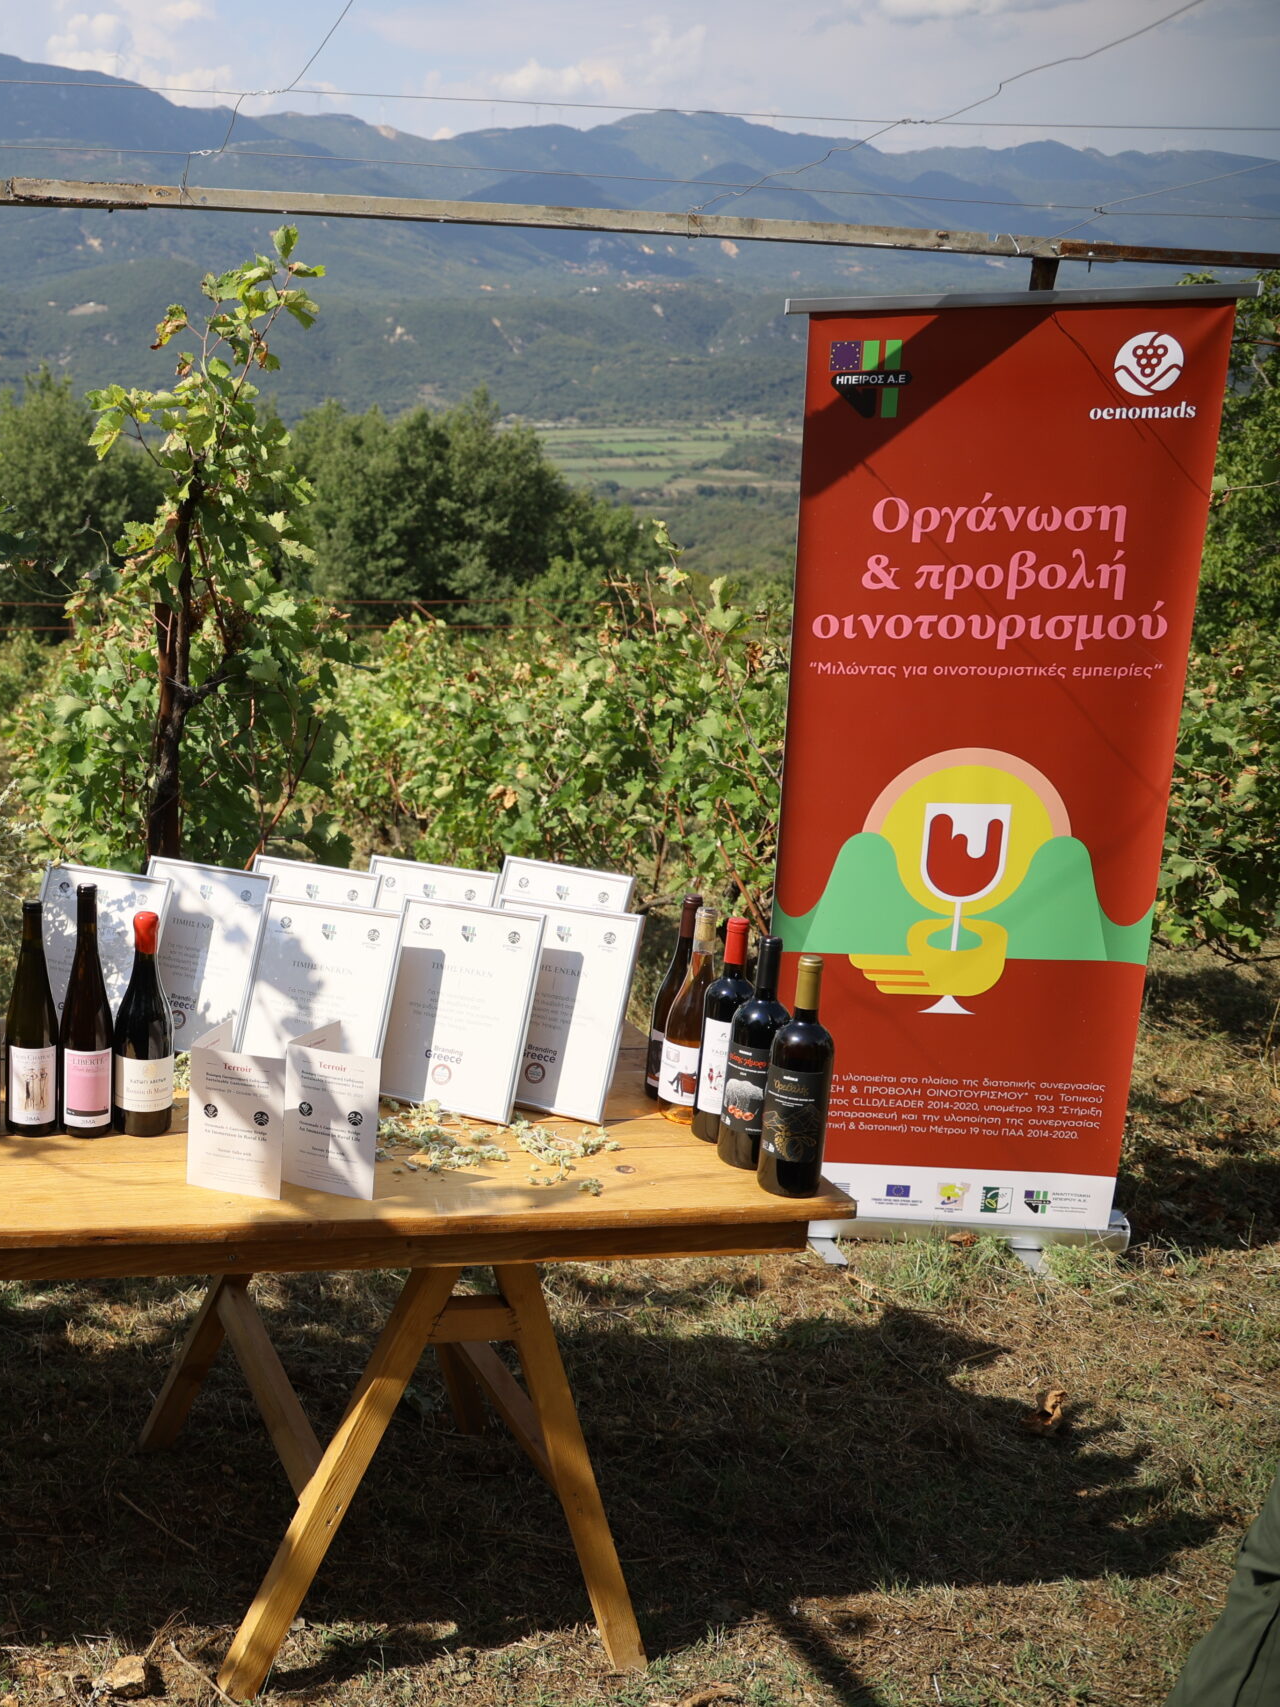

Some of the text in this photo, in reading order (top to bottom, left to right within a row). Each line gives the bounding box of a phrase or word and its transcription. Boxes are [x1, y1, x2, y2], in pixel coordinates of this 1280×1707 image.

[836, 374, 885, 386] ΗΠΕΙΡΟΣ
[1089, 401, 1197, 421] oenomads
[872, 492, 1128, 543] Οργάνωση
[861, 549, 1127, 600] & προβολή
[812, 600, 1169, 651] οινοτουρισμού
[902, 665, 929, 679] για
[933, 663, 1067, 680] οινοτουριστικές
[424, 1049, 462, 1064] Greece
[434, 1045, 464, 1057] Branding
[527, 1044, 558, 1056] Branding
[223, 1063, 252, 1073] Terroir
[319, 1062, 347, 1072] Terroir
[842, 1072, 897, 1083] υλοποιείται
[900, 1076, 918, 1084] στο
[922, 1075, 959, 1086] πλαίσιο
[962, 1078, 979, 1088] της
[982, 1077, 1036, 1090] διατοπικής
[1040, 1081, 1106, 1092] συνεργασίας
[850, 1085, 858, 1094] &
[863, 1086, 921, 1096] ΠΡΟΒΟΛΗ
[1034, 1093, 1054, 1102] του
[1059, 1093, 1103, 1104] Τοπικού
[853, 1097, 924, 1109] CLLD/LEADER
[927, 1101, 980, 1112] 2014-2020,
[984, 1104, 1032, 1114] υπομέτρο
[1037, 1105, 1055, 1114] 19.3
[828, 1110, 1101, 1130] οπαρασκευή και την υλοποίηση της συνεργασίας
[848, 1121, 856, 1130] &
[858, 1121, 908, 1133] διατοπική)
[910, 1125, 927, 1133] του
[929, 1125, 967, 1136] Μέτρου
[969, 1127, 980, 1135] 19
[982, 1128, 999, 1137] του
[1001, 1128, 1025, 1137] ΠΑΑ
[1026, 1129, 1079, 1140] 2014-2020.
